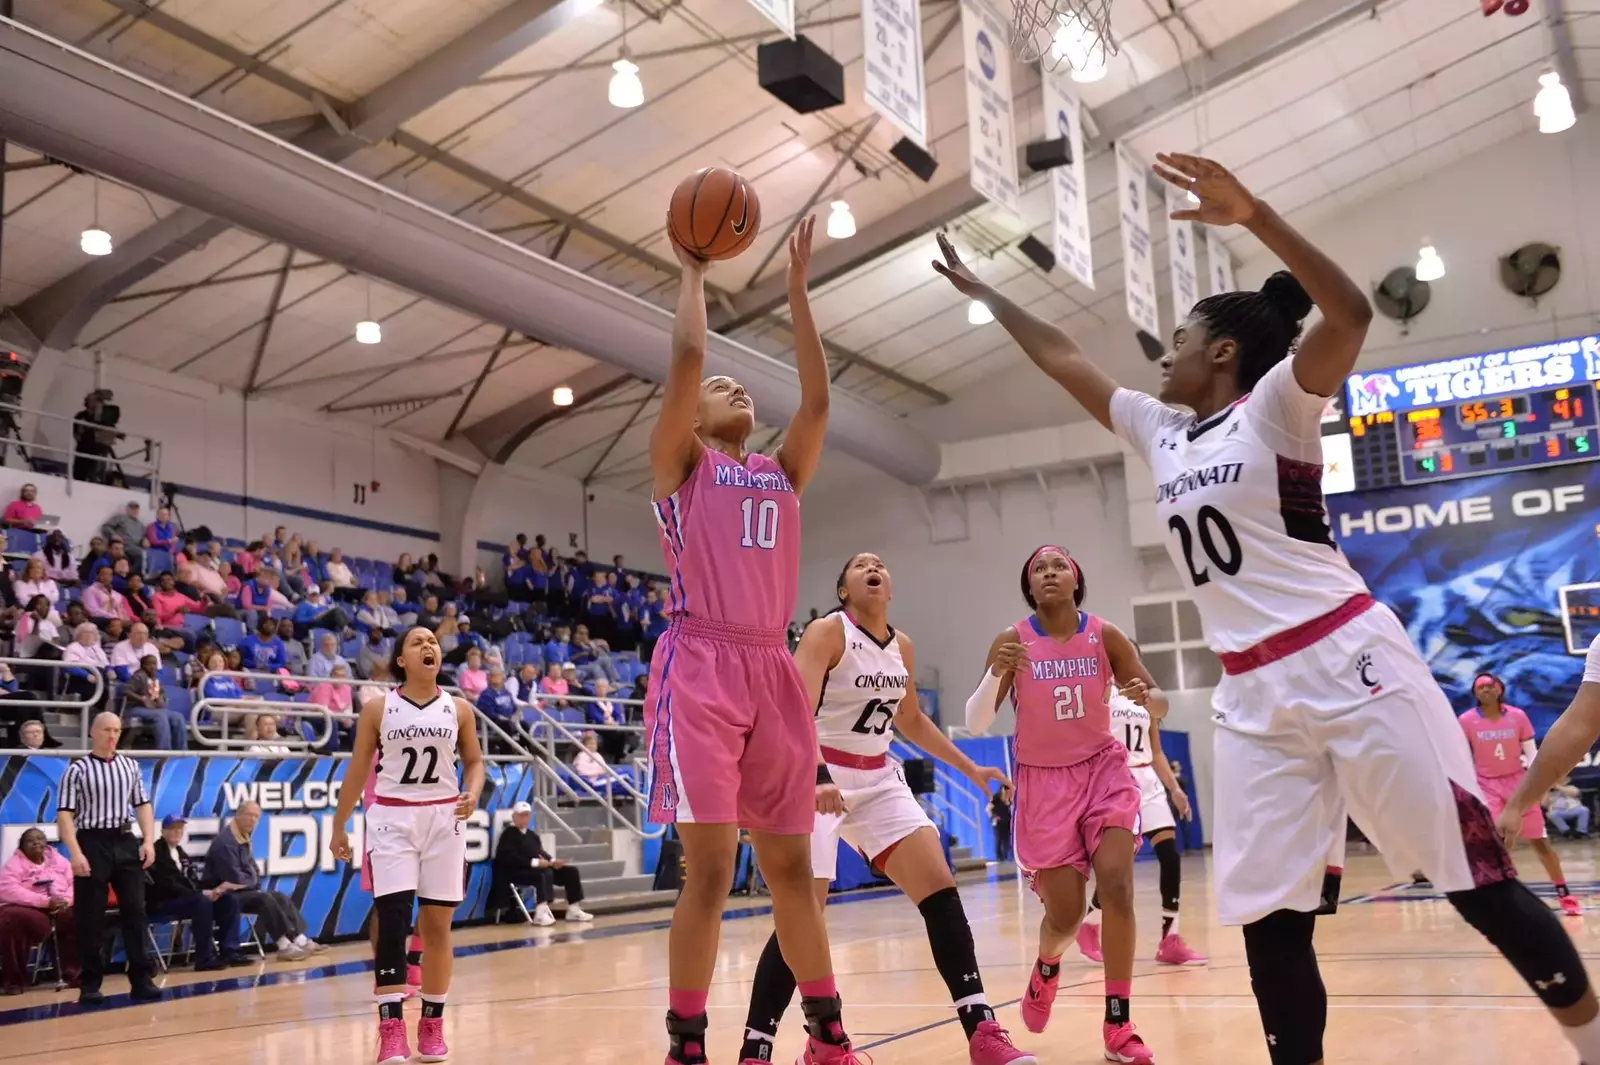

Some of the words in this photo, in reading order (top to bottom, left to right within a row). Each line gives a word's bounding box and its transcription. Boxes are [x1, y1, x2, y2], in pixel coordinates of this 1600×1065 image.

[1405, 355, 1575, 405] TIGERS
[1503, 421, 1516, 438] 3
[1575, 436, 1590, 453] 5
[1156, 462, 1245, 504] CINCINNATI
[741, 497, 779, 549] 10
[1340, 496, 1494, 537] HOME
[1512, 484, 1585, 517] OF
[1168, 504, 1243, 587] 20
[854, 673, 908, 689] CINCINNAT
[1030, 657, 1098, 680] MEMPHIS
[851, 698, 900, 735] 25
[1053, 684, 1086, 721] 21
[387, 726, 452, 741] CINCINNATI
[1125, 723, 1144, 752] 12
[399, 745, 440, 784] 22
[1494, 743, 1505, 760] 4
[223, 781, 365, 810] WELCO
